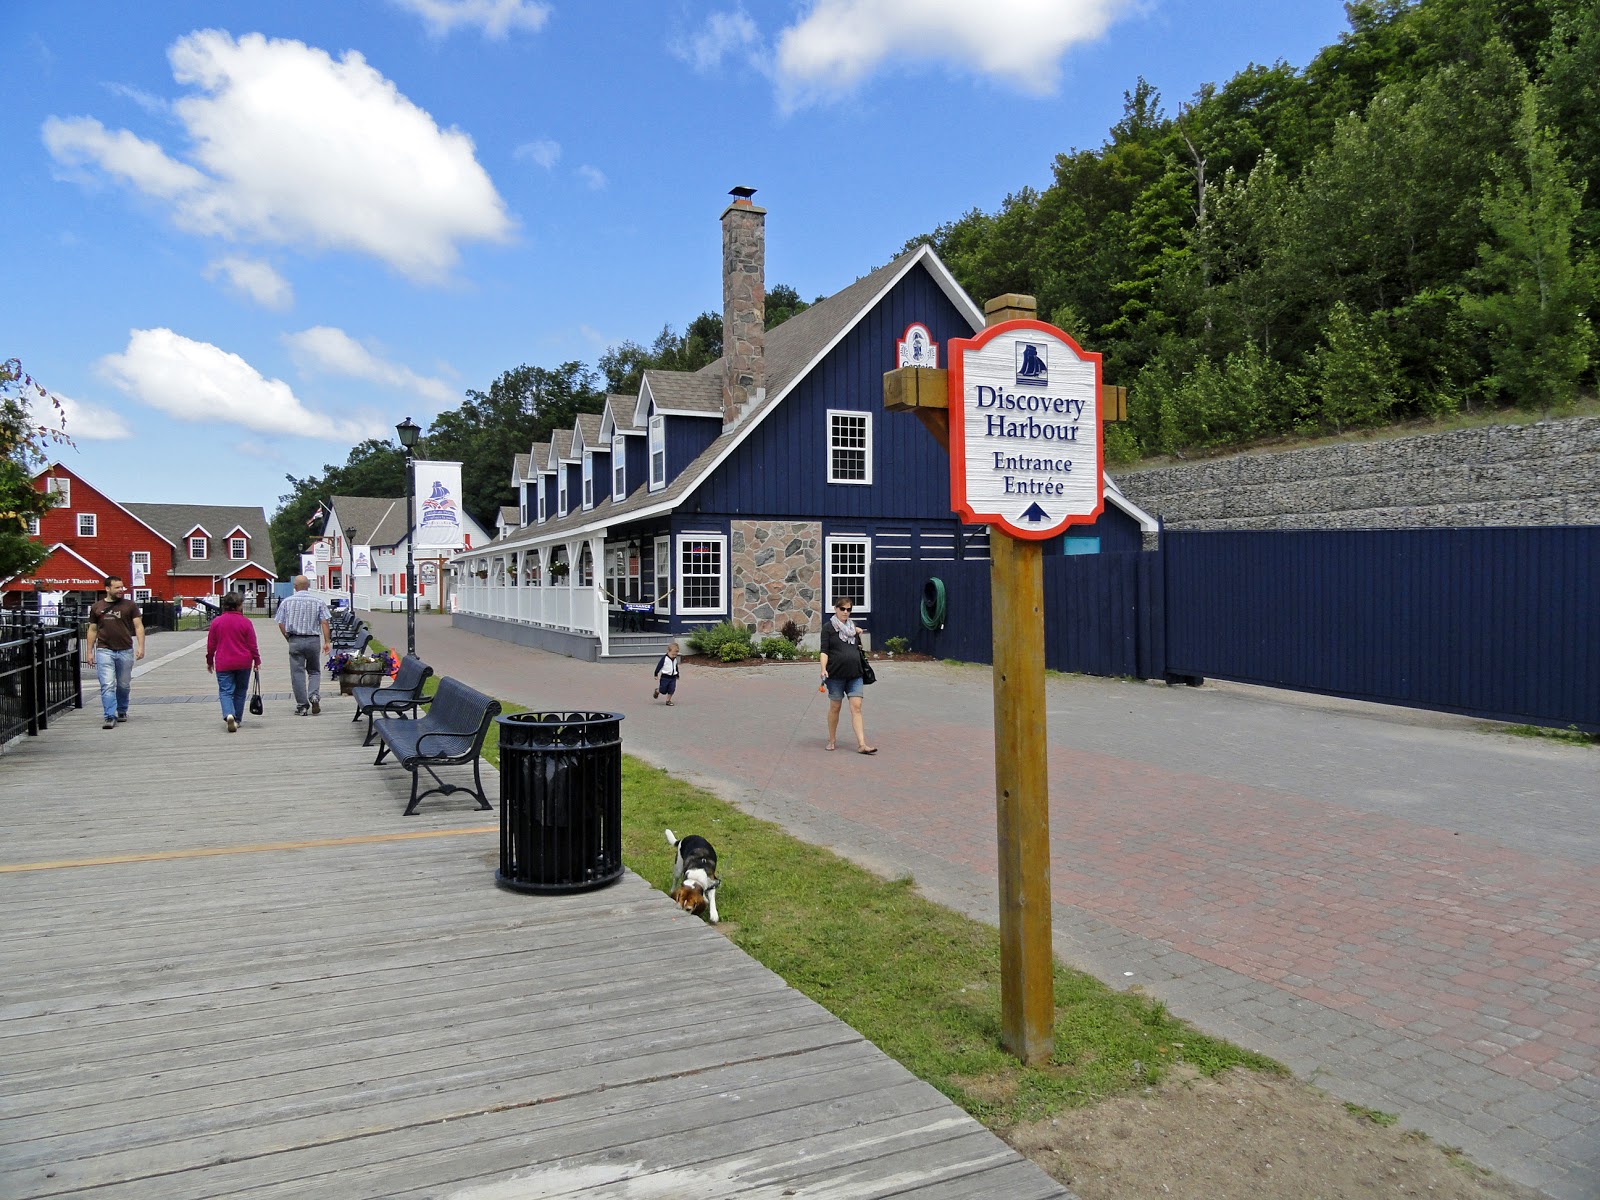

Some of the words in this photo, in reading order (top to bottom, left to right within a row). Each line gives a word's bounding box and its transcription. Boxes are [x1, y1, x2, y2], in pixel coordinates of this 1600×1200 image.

[976, 385, 1085, 421] Discovery
[985, 414, 1079, 442] Harbour
[993, 452, 1072, 472] Entrance
[1003, 476, 1064, 495] Entrée
